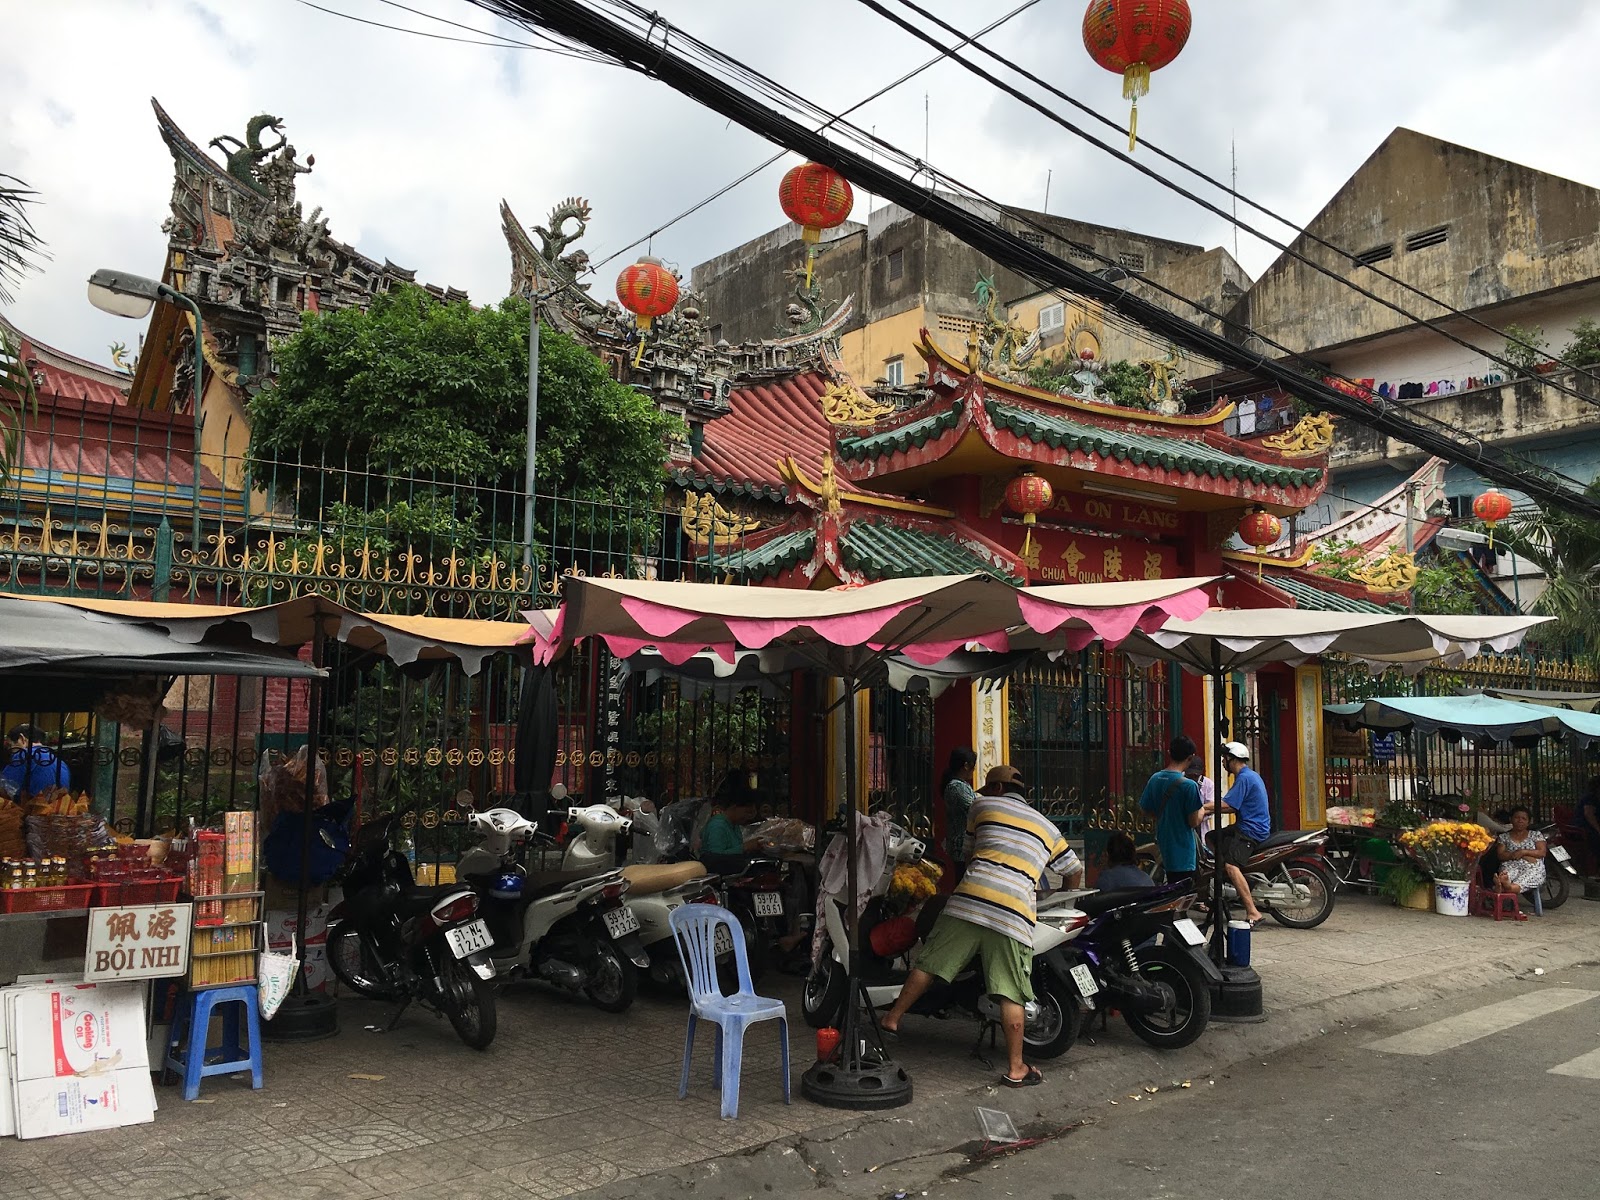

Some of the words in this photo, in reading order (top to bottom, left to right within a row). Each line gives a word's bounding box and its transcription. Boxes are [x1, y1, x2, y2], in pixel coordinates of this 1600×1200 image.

[1041, 565, 1066, 581] CHÙA
[1078, 570, 1103, 583] QUAN
[757, 894, 777, 904] 59-P2
[607, 908, 631, 924] 59-P2
[454, 923, 482, 942] 51-N4
[458, 934, 487, 954] 1241
[140, 945, 181, 968] NHI
[83, 1014, 95, 1049] Cooking
